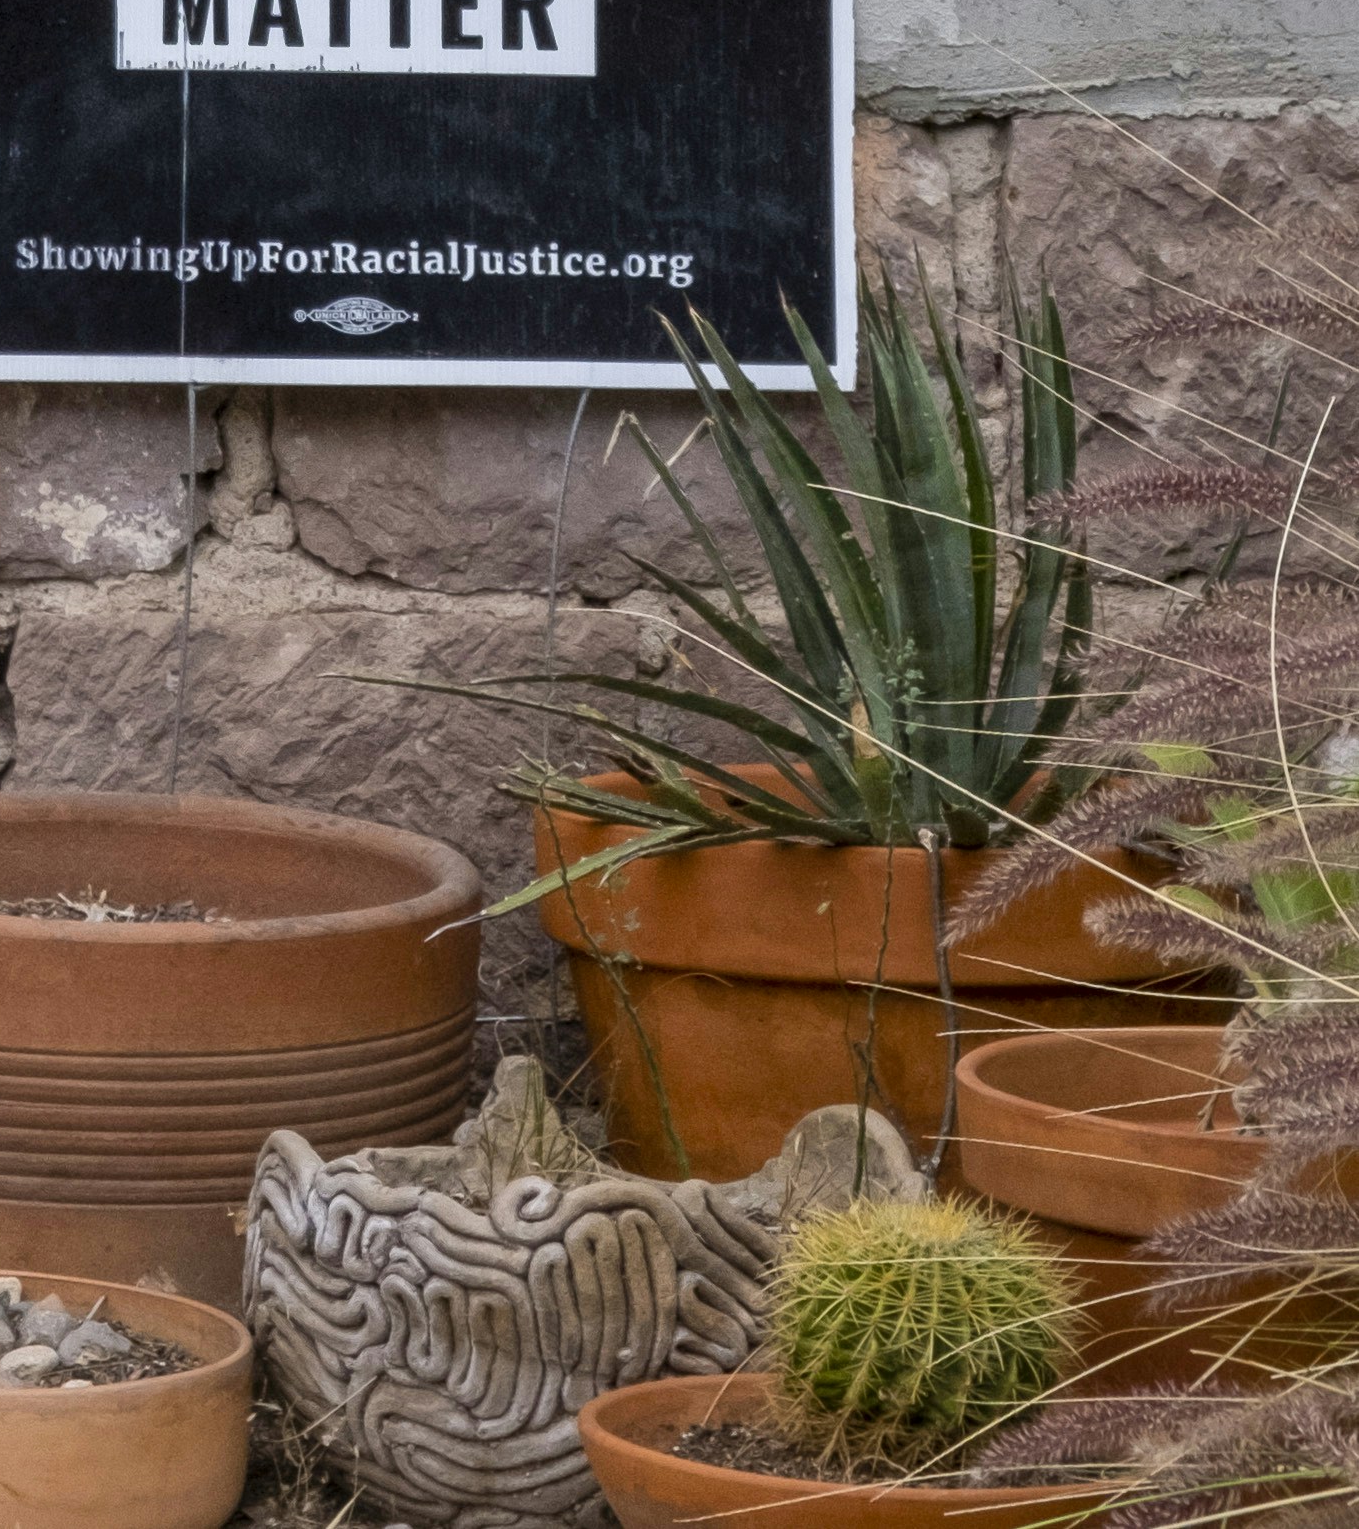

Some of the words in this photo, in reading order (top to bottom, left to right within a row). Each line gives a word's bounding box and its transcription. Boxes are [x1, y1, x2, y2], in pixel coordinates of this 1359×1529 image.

[14, 235, 695, 290] ShowingUpForRacialJustice.org
[314, 311, 347, 321] UNION
[371, 311, 404, 321] LABEL
